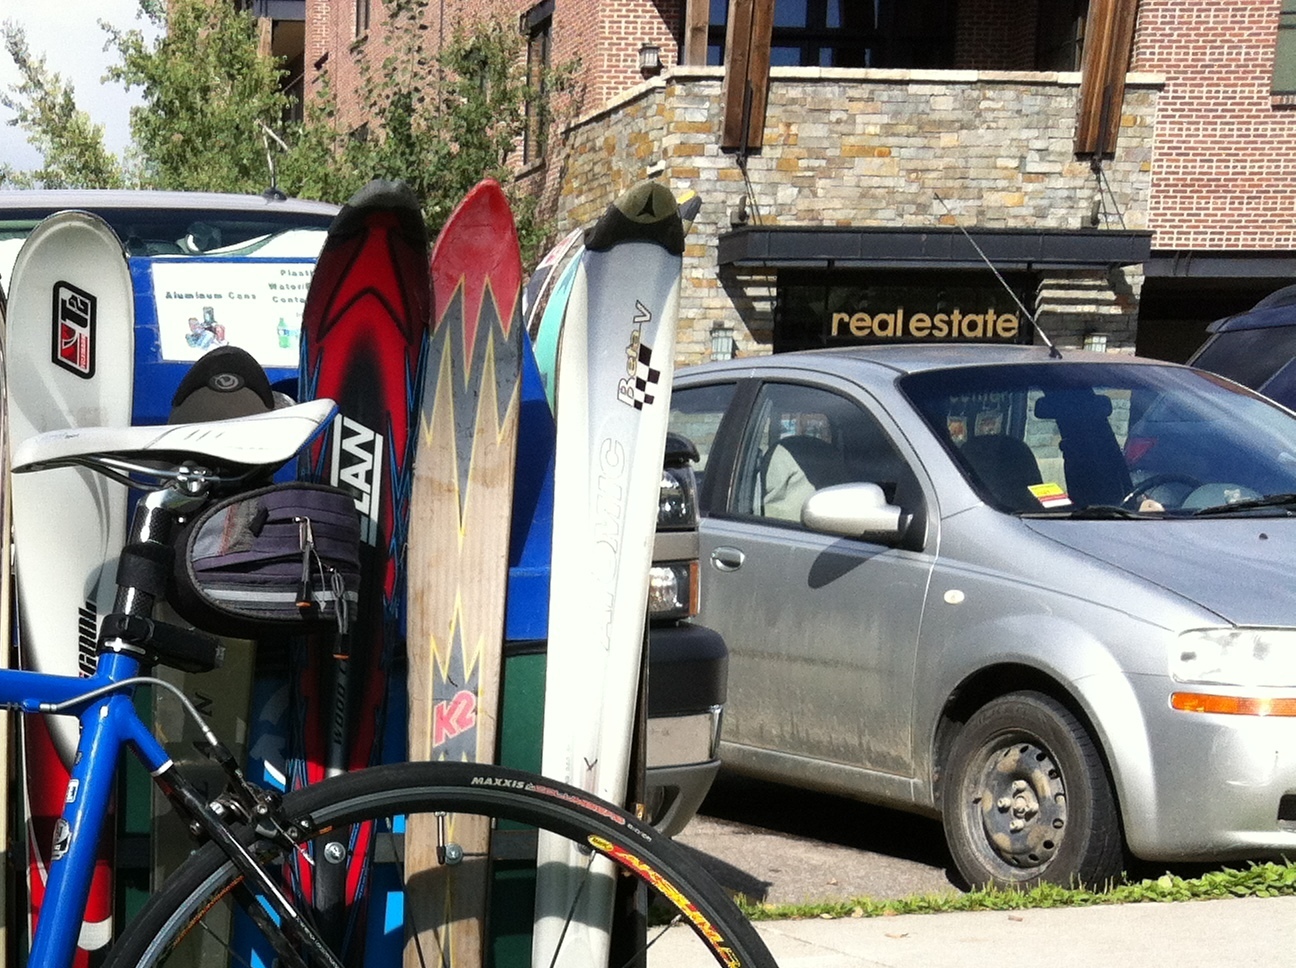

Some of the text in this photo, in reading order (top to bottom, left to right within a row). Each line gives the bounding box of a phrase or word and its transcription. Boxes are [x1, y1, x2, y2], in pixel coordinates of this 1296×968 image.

[165, 291, 223, 300] Aluminum
[831, 307, 1020, 338] real estate
[432, 690, 477, 750] K2
[470, 776, 525, 789] MAXXIS
